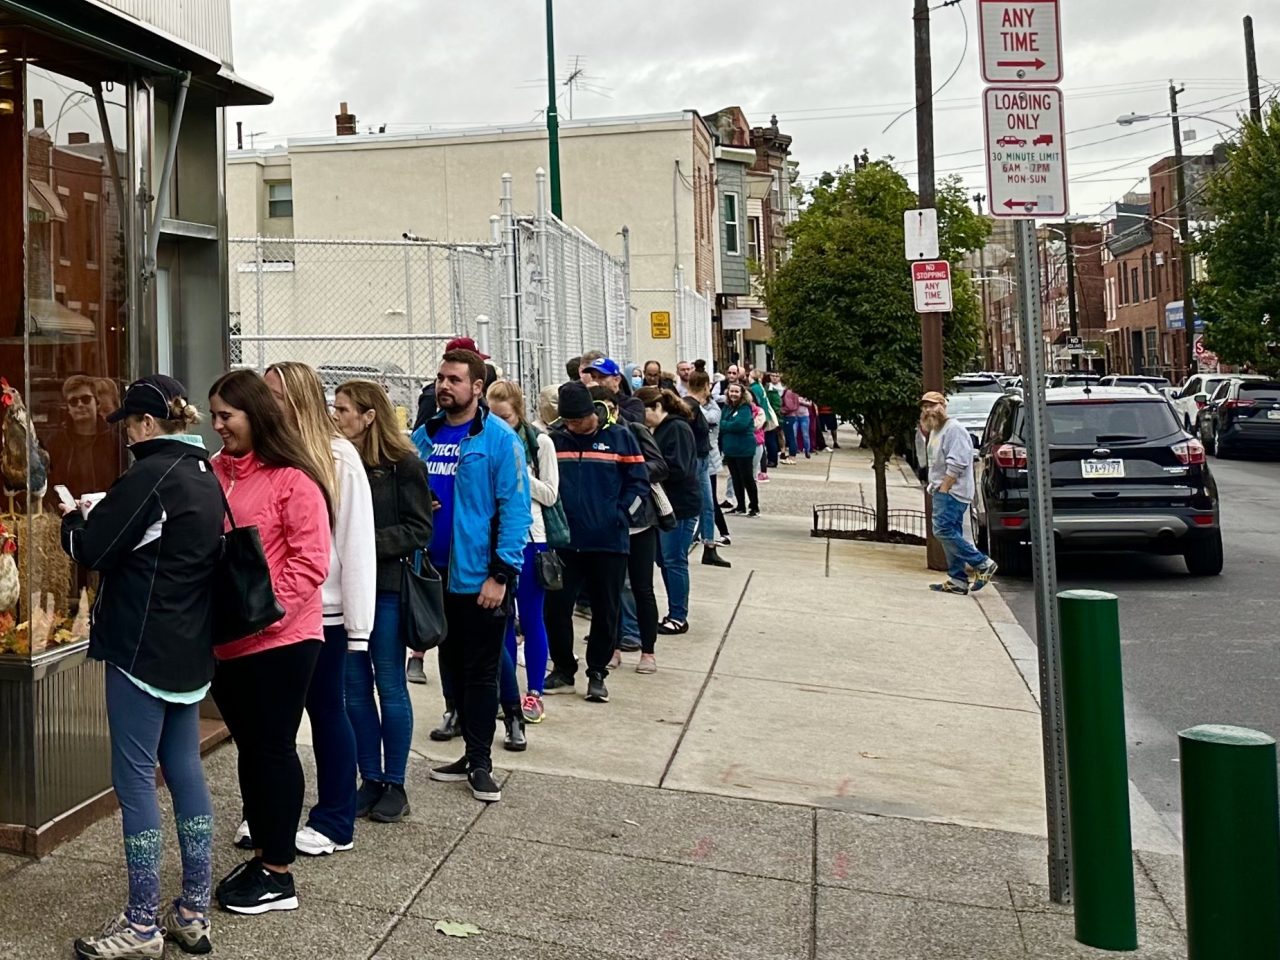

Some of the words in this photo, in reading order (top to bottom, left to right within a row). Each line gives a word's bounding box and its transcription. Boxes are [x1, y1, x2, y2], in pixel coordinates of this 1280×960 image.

[1002, 8, 1035, 28] ANY
[1000, 32, 1040, 52] TIME
[995, 94, 1051, 110] LOADING
[1007, 113, 1040, 130] ONLY
[992, 152, 1002, 161] 30
[1006, 152, 1035, 161] MINUTE
[1039, 152, 1060, 161] LIMIT
[1002, 164, 1020, 172] 6AM
[1031, 164, 1050, 172] 7PM
[916, 271, 946, 280] STOPPING
[924, 282, 940, 290] ANY
[924, 291, 942, 300] TIME
